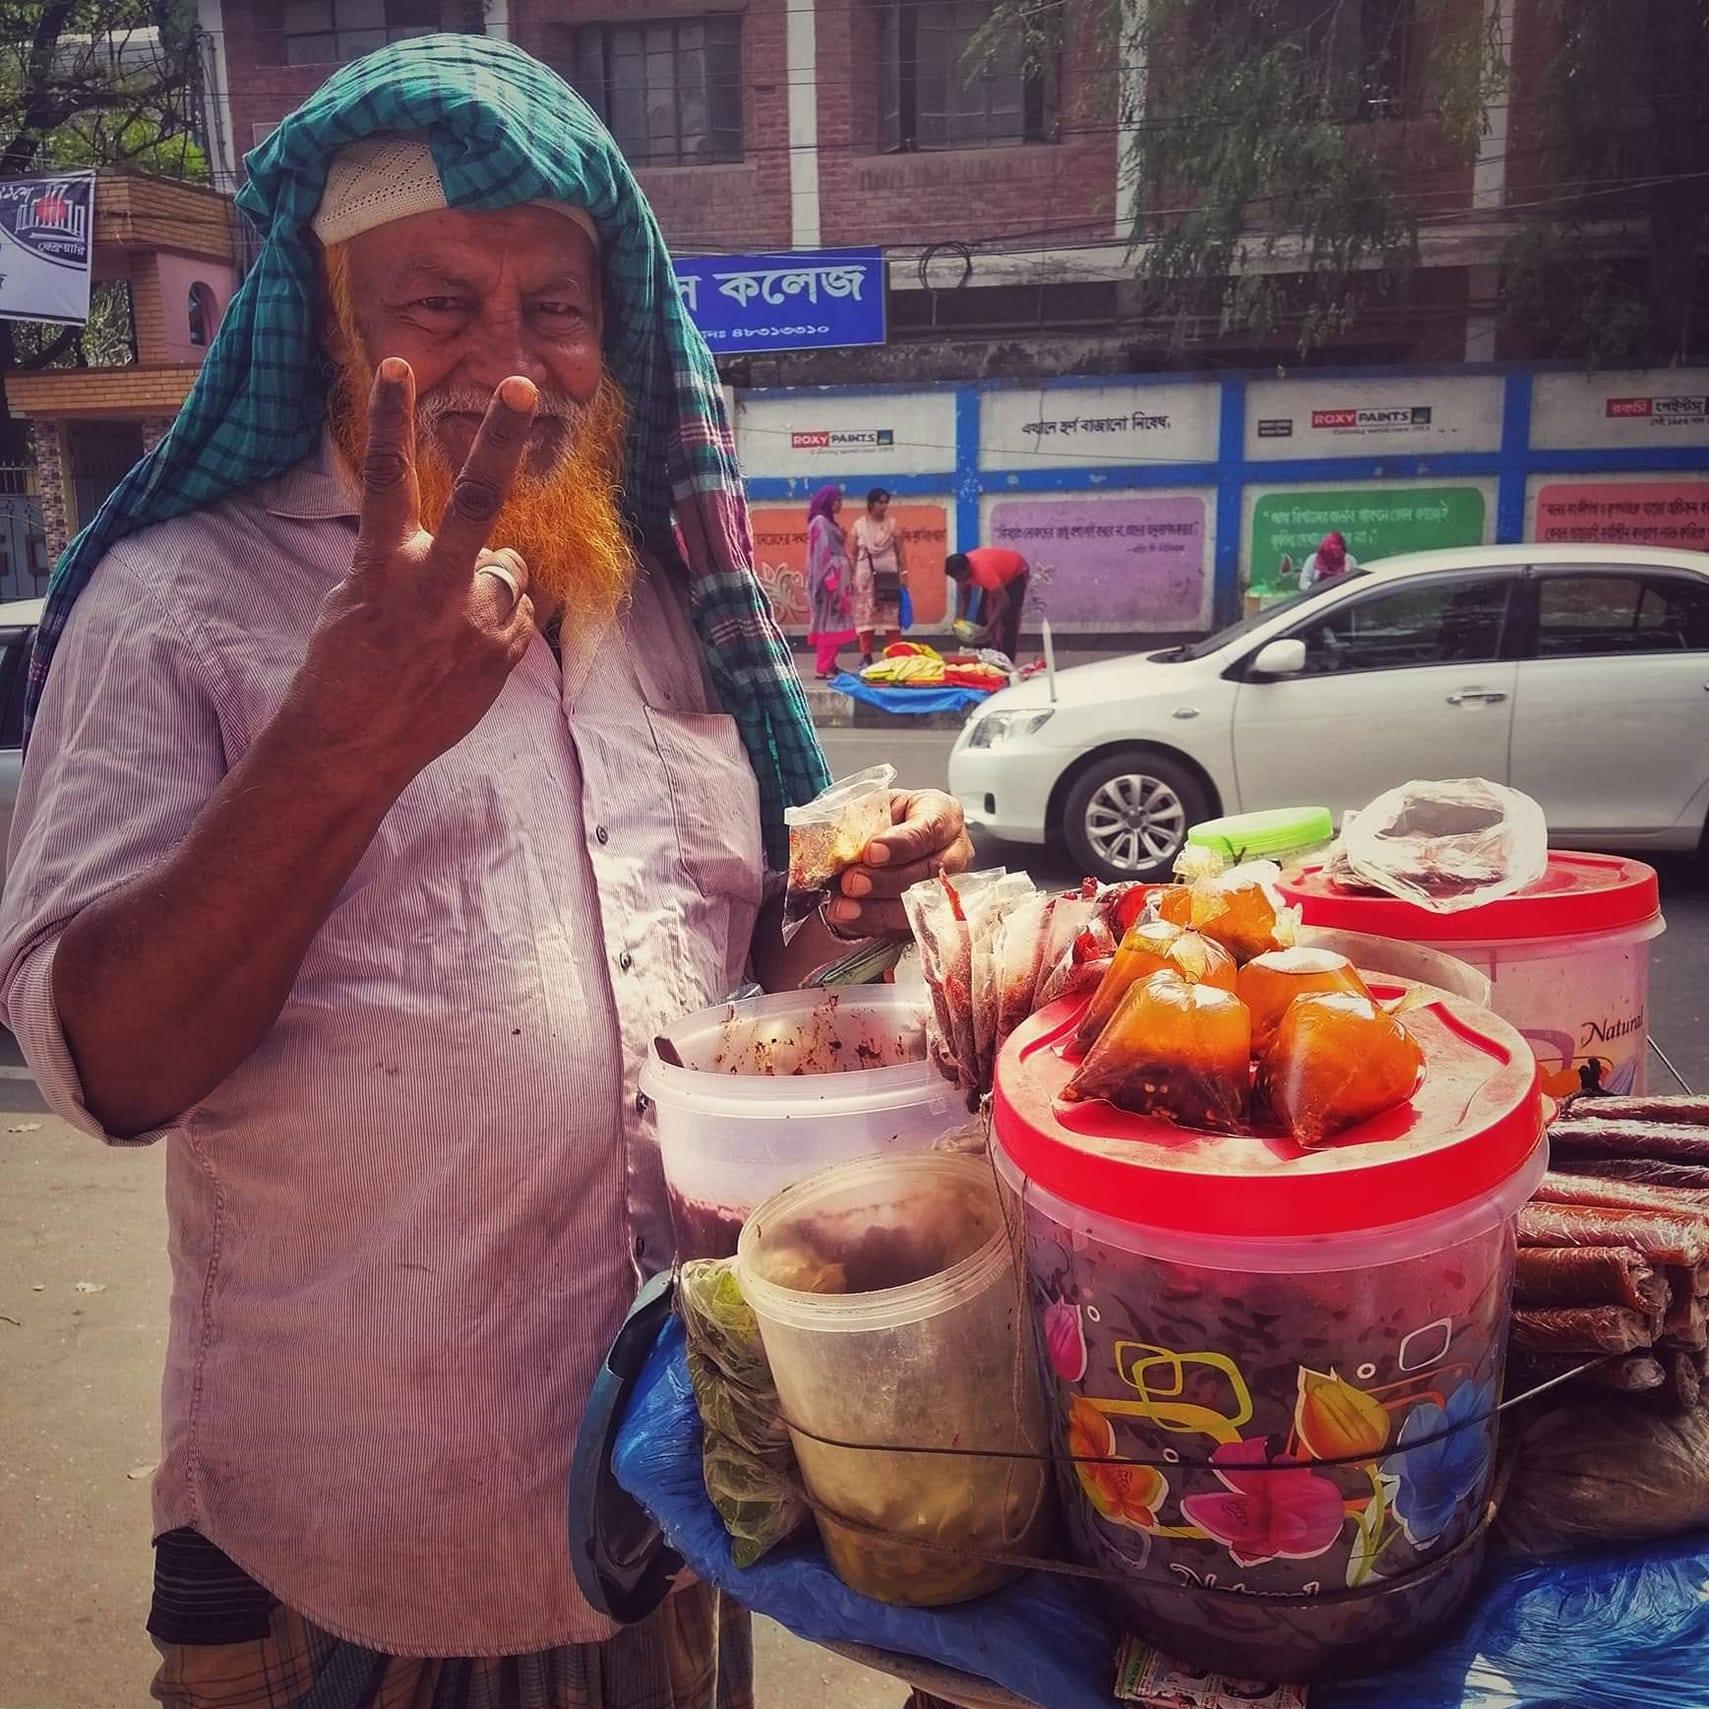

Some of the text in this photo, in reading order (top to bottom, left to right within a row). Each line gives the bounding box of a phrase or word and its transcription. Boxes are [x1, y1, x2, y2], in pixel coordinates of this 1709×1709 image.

[712, 265, 866, 307] কলেজ
[1022, 421, 1057, 435] এখানে
[1081, 416, 1128, 432] বাজানো
[1314, 410, 1409, 425] ROXY PAINTS
[793, 433, 875, 446] ROXY PAINTS
[1580, 1005, 1645, 1048] Natural
